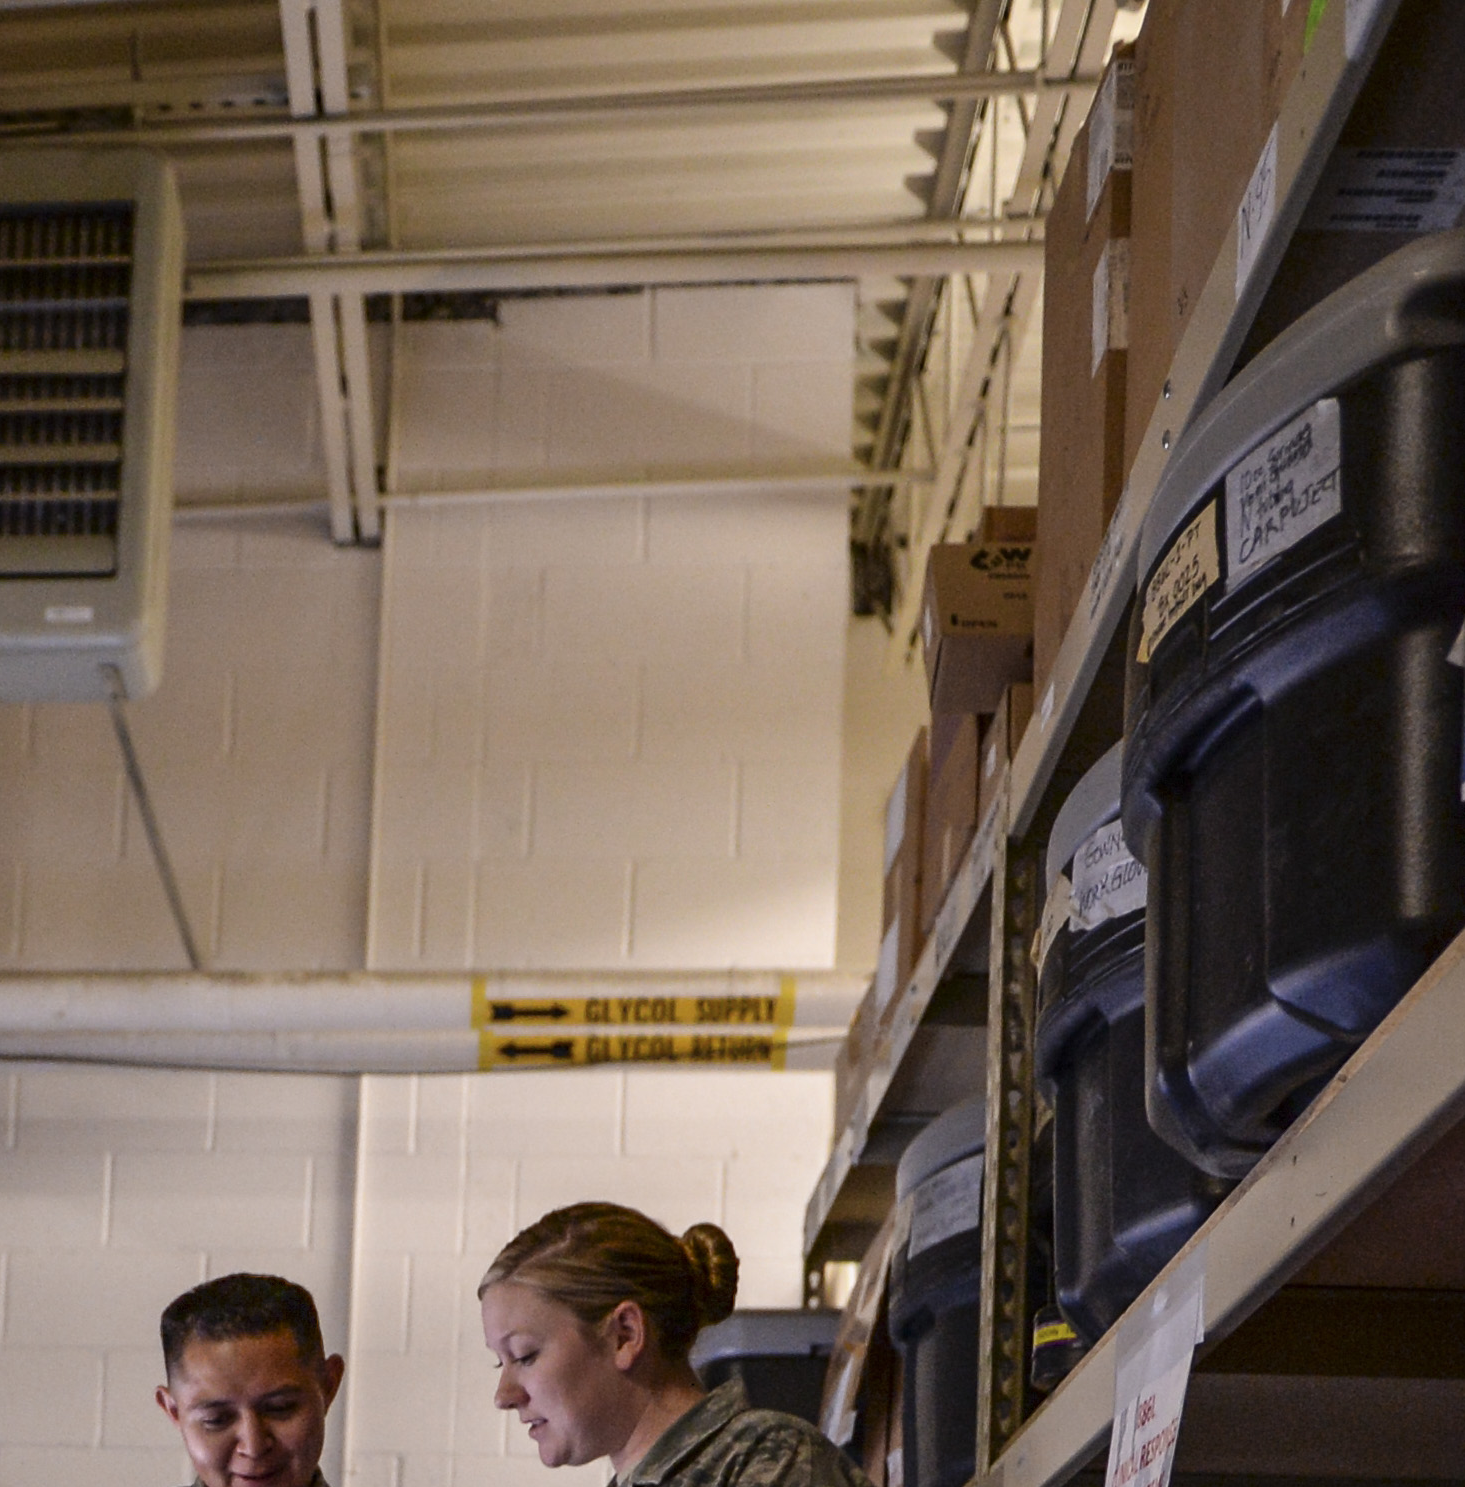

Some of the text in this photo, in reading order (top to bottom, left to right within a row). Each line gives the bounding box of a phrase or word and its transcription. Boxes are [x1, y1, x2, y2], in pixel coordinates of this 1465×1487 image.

[586, 995, 776, 1023] GLYCOL SUPPLY
[586, 1034, 675, 1062] GLYCOL
